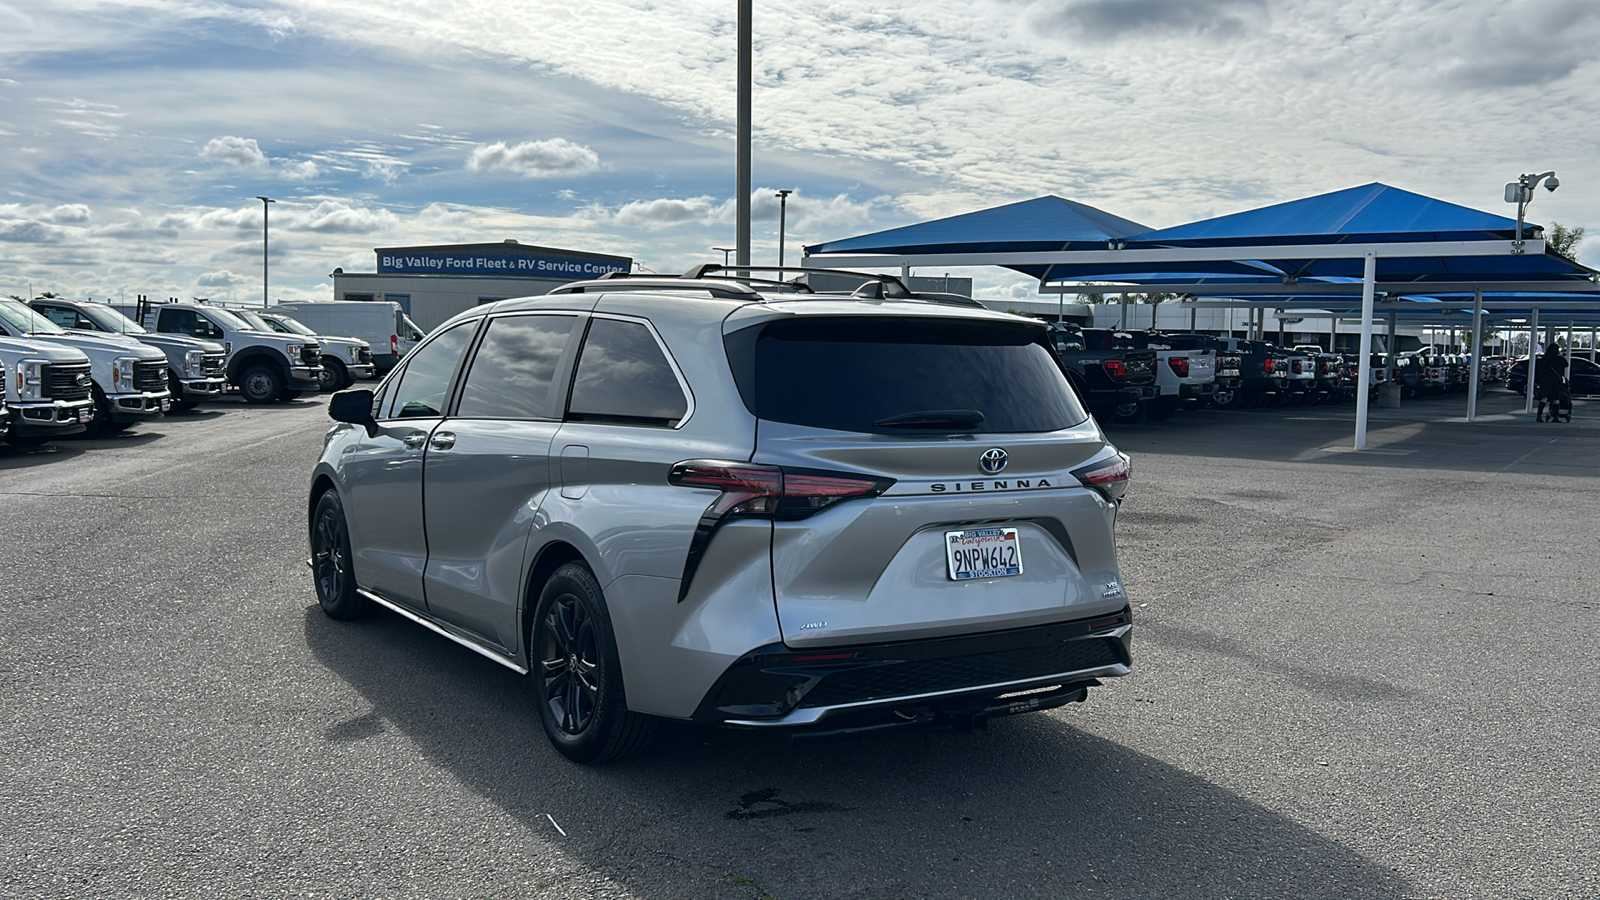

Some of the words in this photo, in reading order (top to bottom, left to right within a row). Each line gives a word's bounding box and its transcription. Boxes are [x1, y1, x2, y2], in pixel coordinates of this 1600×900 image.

[382, 256, 403, 269] Big
[405, 256, 443, 269] Valley
[446, 257, 474, 269] Ford
[476, 257, 507, 269] Fleet
[508, 261, 516, 269] &
[518, 259, 536, 270] RV
[537, 260, 582, 272] Service
[583, 263, 624, 274] Center
[930, 479, 1052, 492] SIENNA
[977, 529, 1001, 538] VALLEY
[954, 546, 1017, 572] 9NPW642
[969, 568, 1007, 578] STOCKTON
[800, 621, 828, 630] AWD
